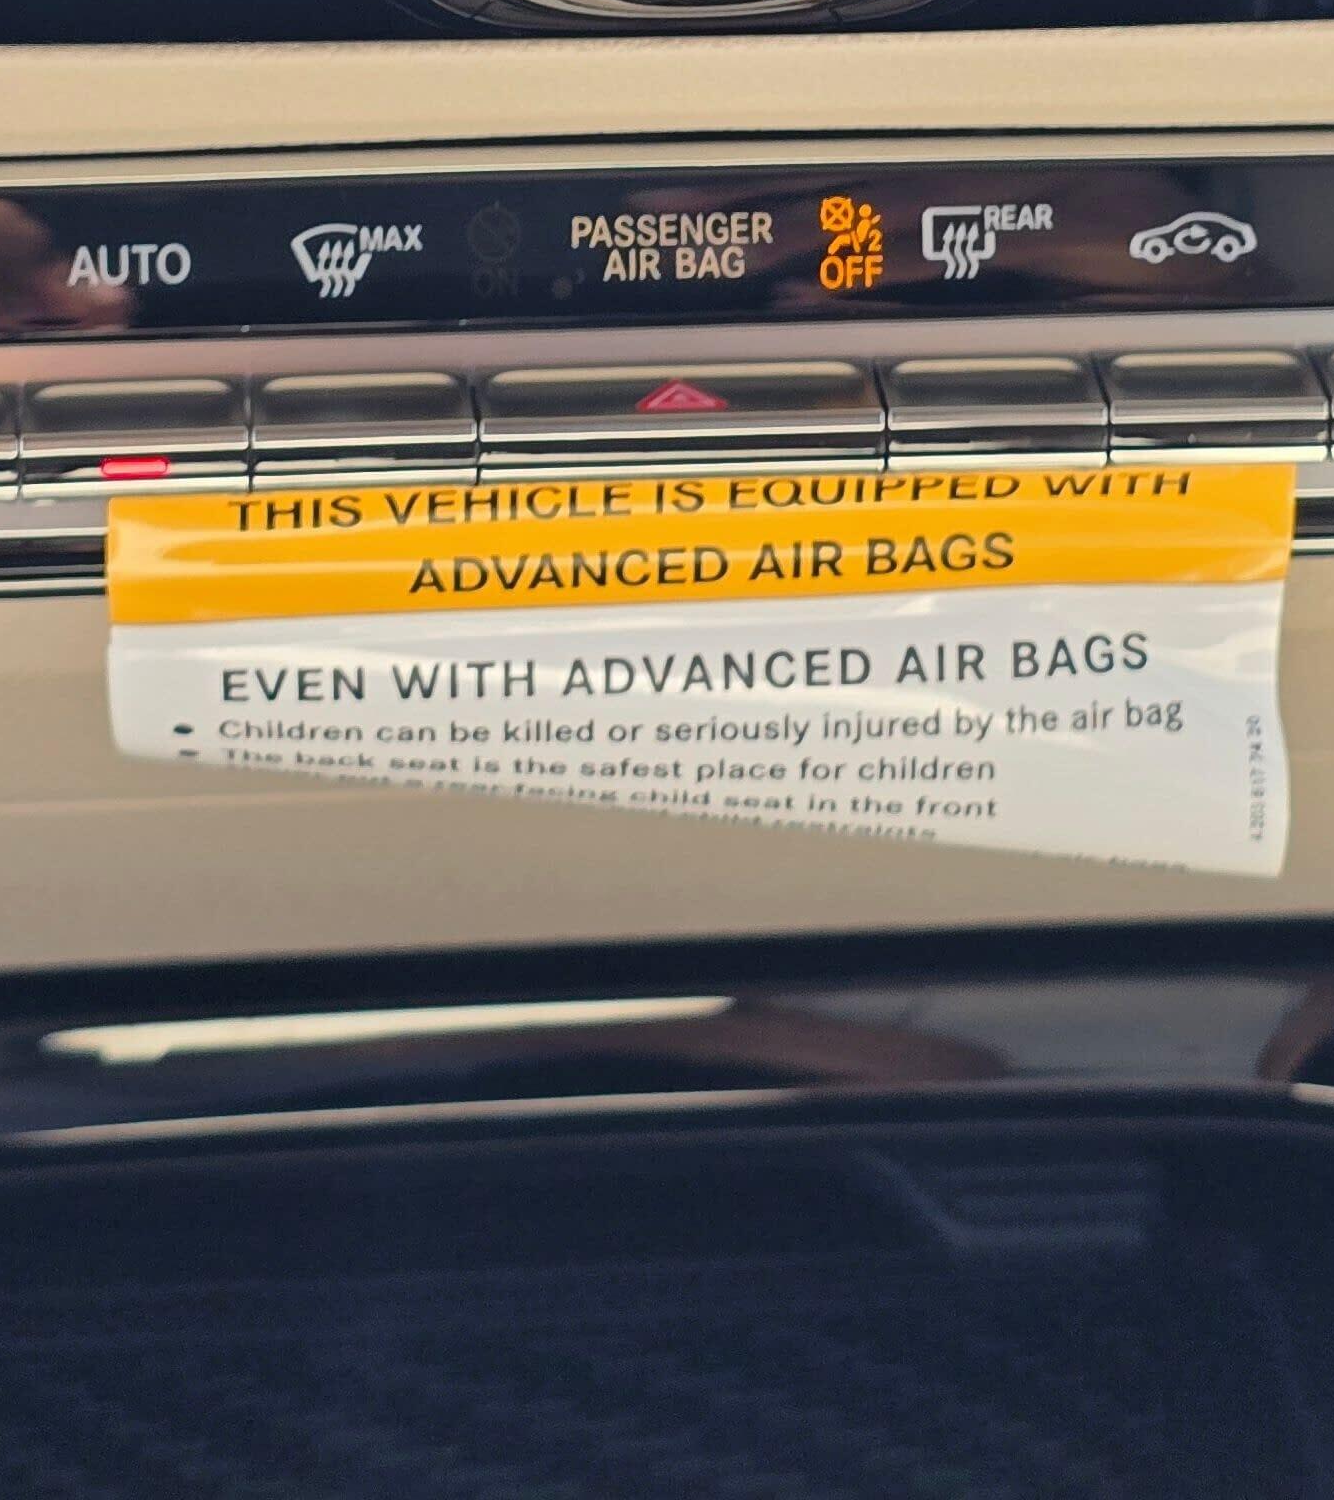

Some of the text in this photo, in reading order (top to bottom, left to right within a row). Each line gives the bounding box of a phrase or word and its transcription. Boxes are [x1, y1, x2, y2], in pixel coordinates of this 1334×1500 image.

[570, 211, 773, 248] PASSENGER
[983, 204, 1054, 231] REAR
[358, 224, 423, 254] MAX
[68, 243, 191, 287] AUTO
[603, 246, 746, 281] AIR BAG
[820, 255, 884, 290] OFF
[229, 471, 1192, 532] THIS VEHICLE IS EQUIPPED WITH
[408, 531, 1015, 594] ADVANCED AIR BAGS
[221, 632, 1149, 702] EVEN WITH ADVANCED AIR BAGS
[217, 699, 1185, 748] Children can be killed or seriously injured by the air bag
[389, 756, 459, 773] seat
[473, 755, 501, 774] is
[513, 757, 568, 776] the
[579, 757, 683, 780] safest
[695, 756, 788, 784] place
[799, 755, 847, 782] for
[857, 755, 996, 782] children
[723, 793, 795, 812] seat
[807, 793, 837, 813] in
[849, 794, 904, 816] the
[916, 794, 998, 819] front
